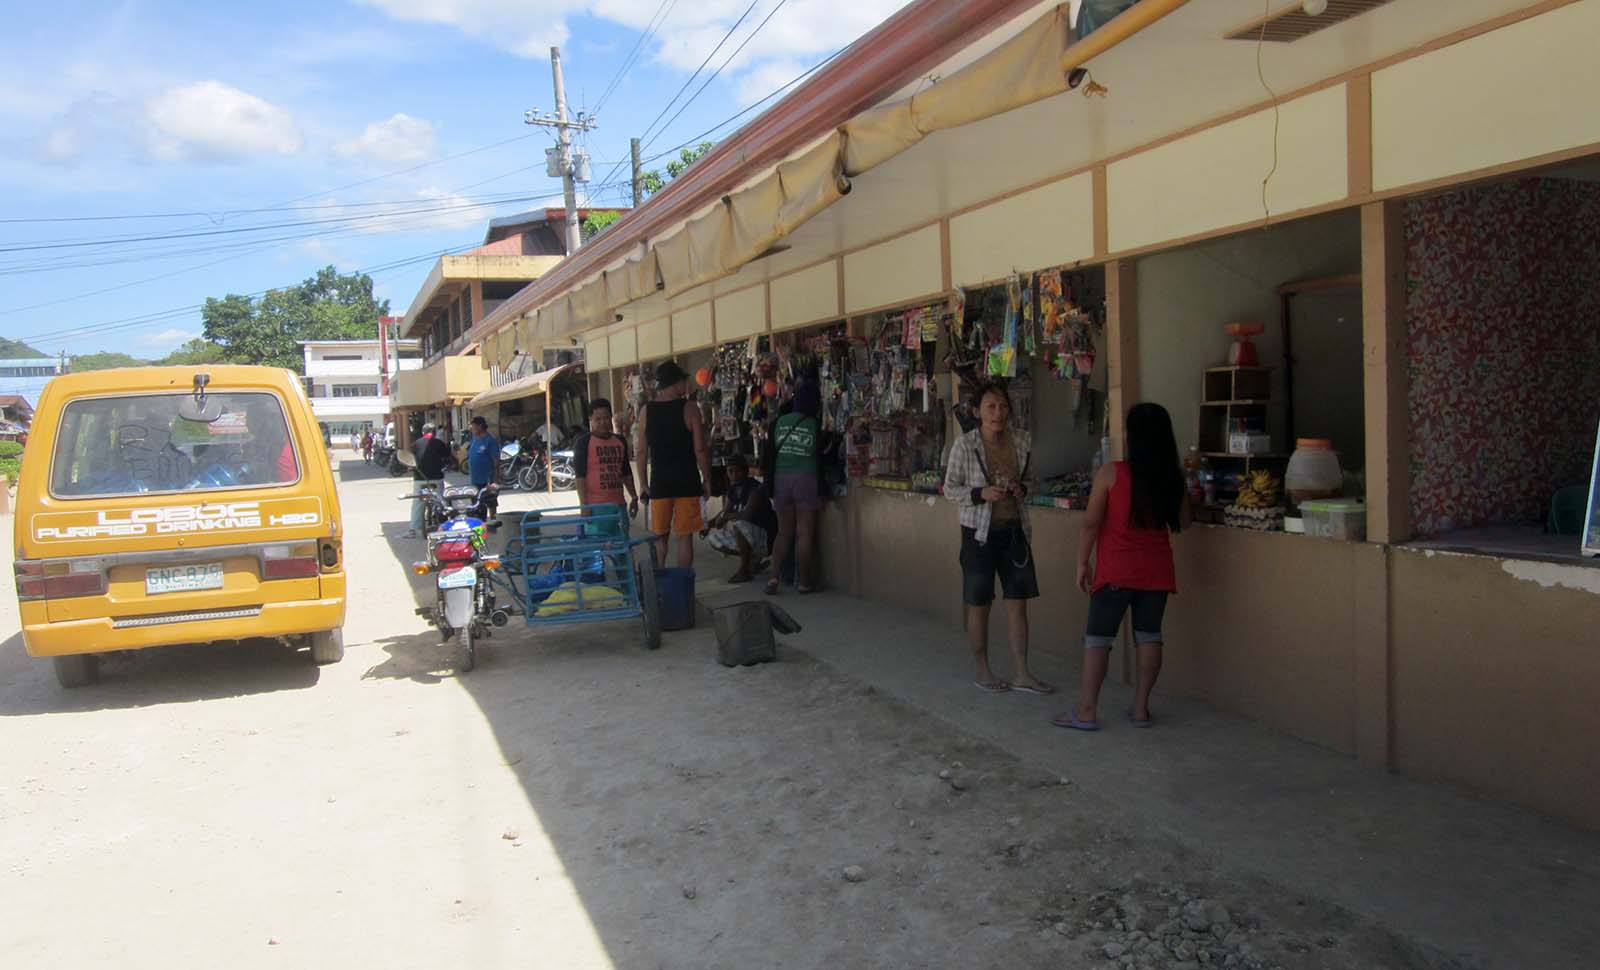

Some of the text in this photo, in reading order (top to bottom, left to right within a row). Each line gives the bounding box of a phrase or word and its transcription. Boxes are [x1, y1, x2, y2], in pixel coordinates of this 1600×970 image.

[98, 502, 260, 525] LOBOC
[37, 524, 147, 539] PURIFIED
[157, 516, 261, 533] DRINKING
